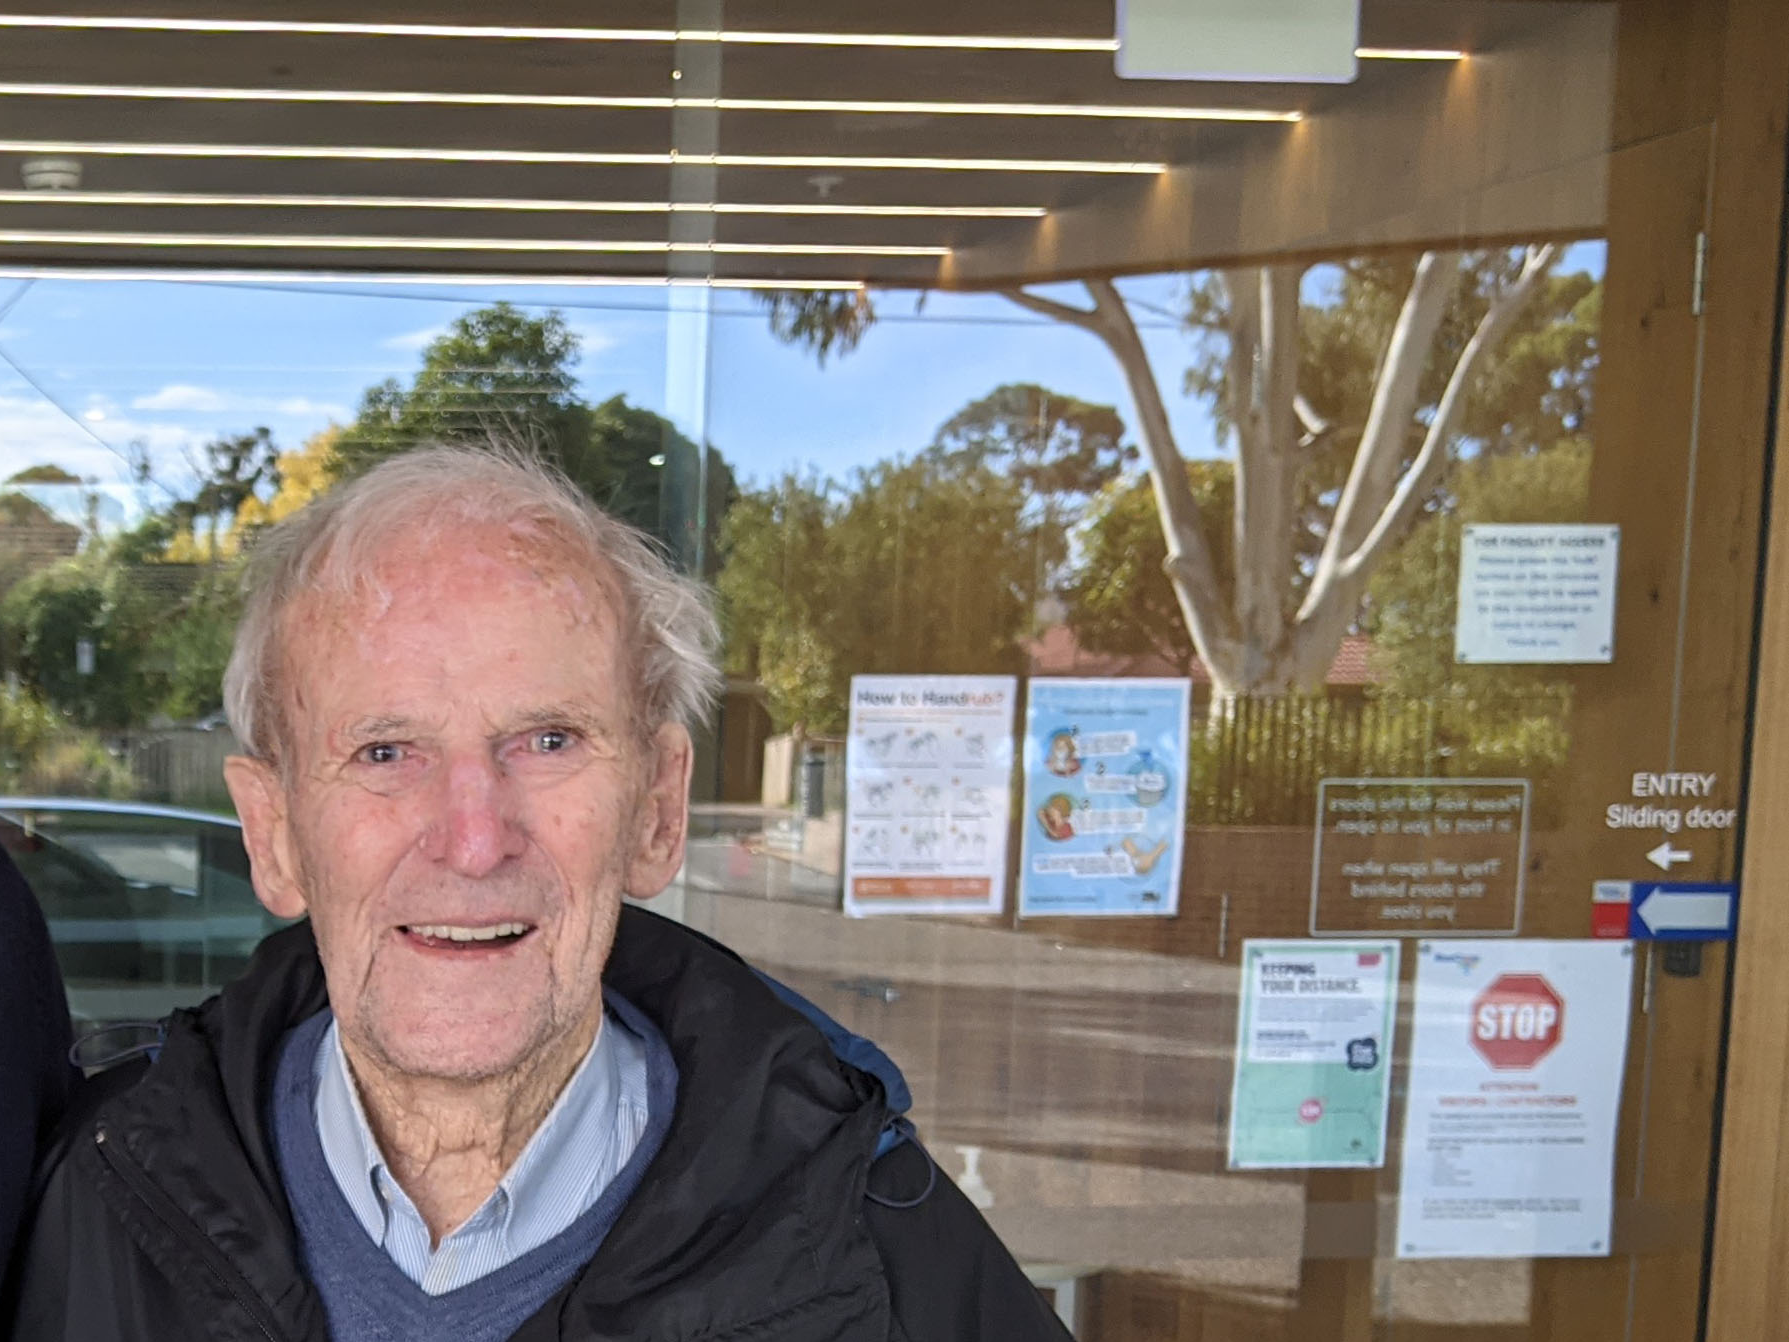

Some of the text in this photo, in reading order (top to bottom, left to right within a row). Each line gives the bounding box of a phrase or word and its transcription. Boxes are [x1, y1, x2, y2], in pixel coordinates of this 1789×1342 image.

[857, 691, 1003, 706] How to Handrub?
[1632, 772, 1717, 797] ENTRY
[1605, 804, 1737, 833] Sliding door
[1261, 963, 1316, 975] KEEPING
[1260, 979, 1294, 993] YOUR
[1477, 1003, 1558, 1042] STOP
